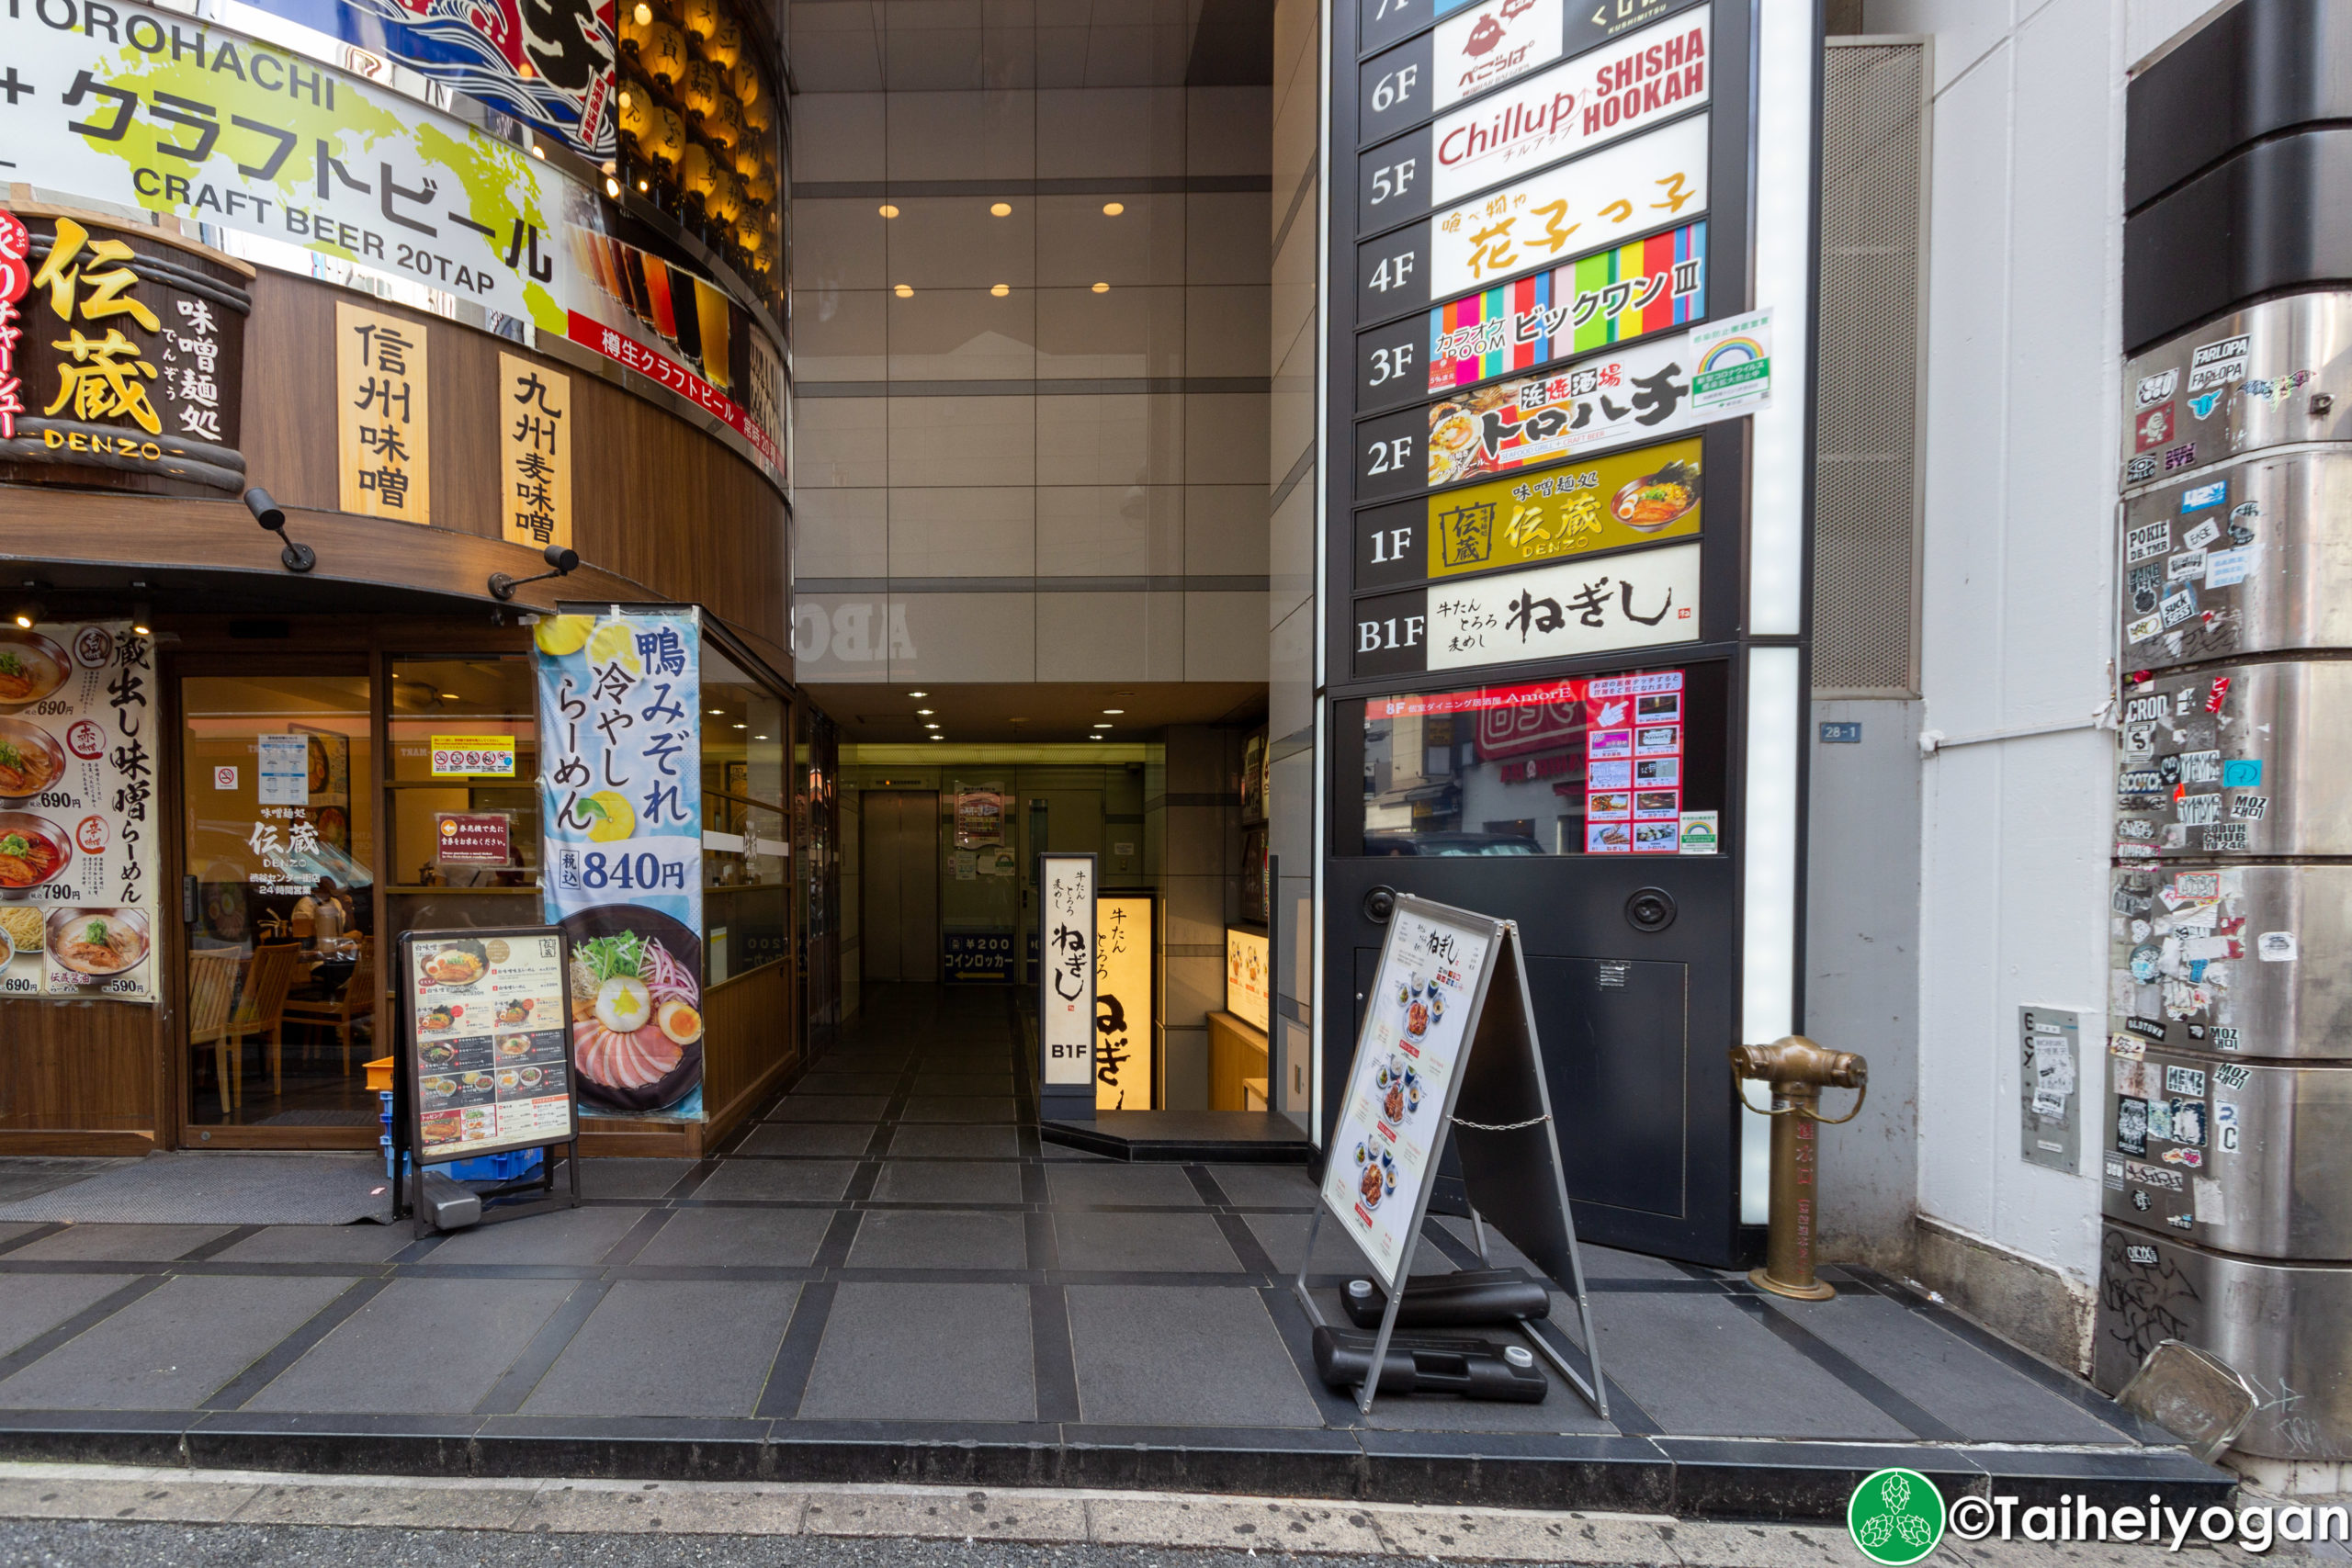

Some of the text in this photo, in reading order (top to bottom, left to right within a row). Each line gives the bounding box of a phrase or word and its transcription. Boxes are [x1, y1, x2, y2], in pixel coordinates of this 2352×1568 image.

[1608, 4, 1667, 34] KUSHIMITSU
[1597, 28, 1705, 97] SHISHA
[1372, 63, 1418, 112] 6F
[1584, 61, 1703, 137] HOOKAH
[1438, 92, 1576, 166] Chillup
[1503, 124, 1574, 164] チルアップ
[62, 70, 552, 283] クラフトビール
[1372, 159, 1416, 206] 5F
[133, 168, 495, 296] CRAFT BEER 20TAP
[1368, 253, 1415, 293] 4F
[33, 217, 162, 435] 伝蔵
[1436, 319, 1507, 353] カラオケ
[162, 327, 179, 400] でんぞう
[1370, 343, 1413, 387] 3F
[2195, 339, 2247, 365] FARLOPA
[176, 299, 222, 441] 味噌麺処
[602, 328, 734, 422] 樽生クラフトビール
[1521, 364, 1621, 410] 浜焼酒場
[355, 323, 413, 511] 信州味噌
[1481, 362, 1689, 459] トロハチ
[44, 429, 161, 460] DENZO
[514, 372, 561, 545] 九州麦味噌
[1367, 436, 1412, 476] 2F
[1501, 446, 1533, 460] SEAFOOD
[1535, 443, 1553, 454] GRILL
[1563, 435, 1585, 446] CRAFT
[1587, 431, 1605, 441] BEER
[1512, 471, 1599, 502] 味噌麺処
[1453, 512, 1480, 562] 伝蔵
[1504, 492, 1603, 547] 伝蔵
[2130, 523, 2167, 547] POKIE
[1370, 528, 1412, 563] 1F
[1523, 536, 1589, 558] DENZO
[1437, 598, 1481, 617] 牛たん
[1461, 614, 1498, 631] とろろ
[1505, 576, 1672, 644] ねぎし
[1358, 615, 1425, 652] B1F
[1449, 635, 1485, 651] 麦めし
[1385, 687, 1571, 715] 8F 個室ダイニング居酒屋 AmorE
[2128, 695, 2167, 722] CROD
[593, 661, 636, 786] 冷やし
[635, 626, 689, 823] 鴨みぞれ
[1825, 727, 1856, 738] 28-1
[107, 627, 152, 903] 蔵出し味噌らーめん
[555, 678, 593, 829] らーめん
[260, 808, 306, 818] 味噌麺処
[2235, 795, 2267, 808] MOZ
[248, 821, 320, 855] 伝蔵
[2205, 833, 2245, 842] CHUB
[263, 859, 307, 868] DENZO
[561, 852, 684, 890] 税込 840円
[259, 886, 311, 896] 24時間営業
[1053, 878, 1064, 909] 麦めし
[1067, 886, 1075, 917] とろろ
[1075, 871, 1086, 900] 牛たん
[967, 939, 1010, 950] ¥200
[1110, 908, 1127, 953] 牛たん
[1427, 929, 1459, 964] ねぎし
[945, 954, 1013, 967] コインロッカー
[1051, 921, 1088, 1001] ねぎし
[1096, 932, 1108, 979] とろろ
[2128, 1020, 2164, 1037] OLDTOWN
[2210, 1028, 2237, 1039] MOZ
[1052, 1044, 1087, 1058] B1F
[2218, 1064, 2250, 1079] MOZ
[421, 1112, 444, 1121] トッピング
